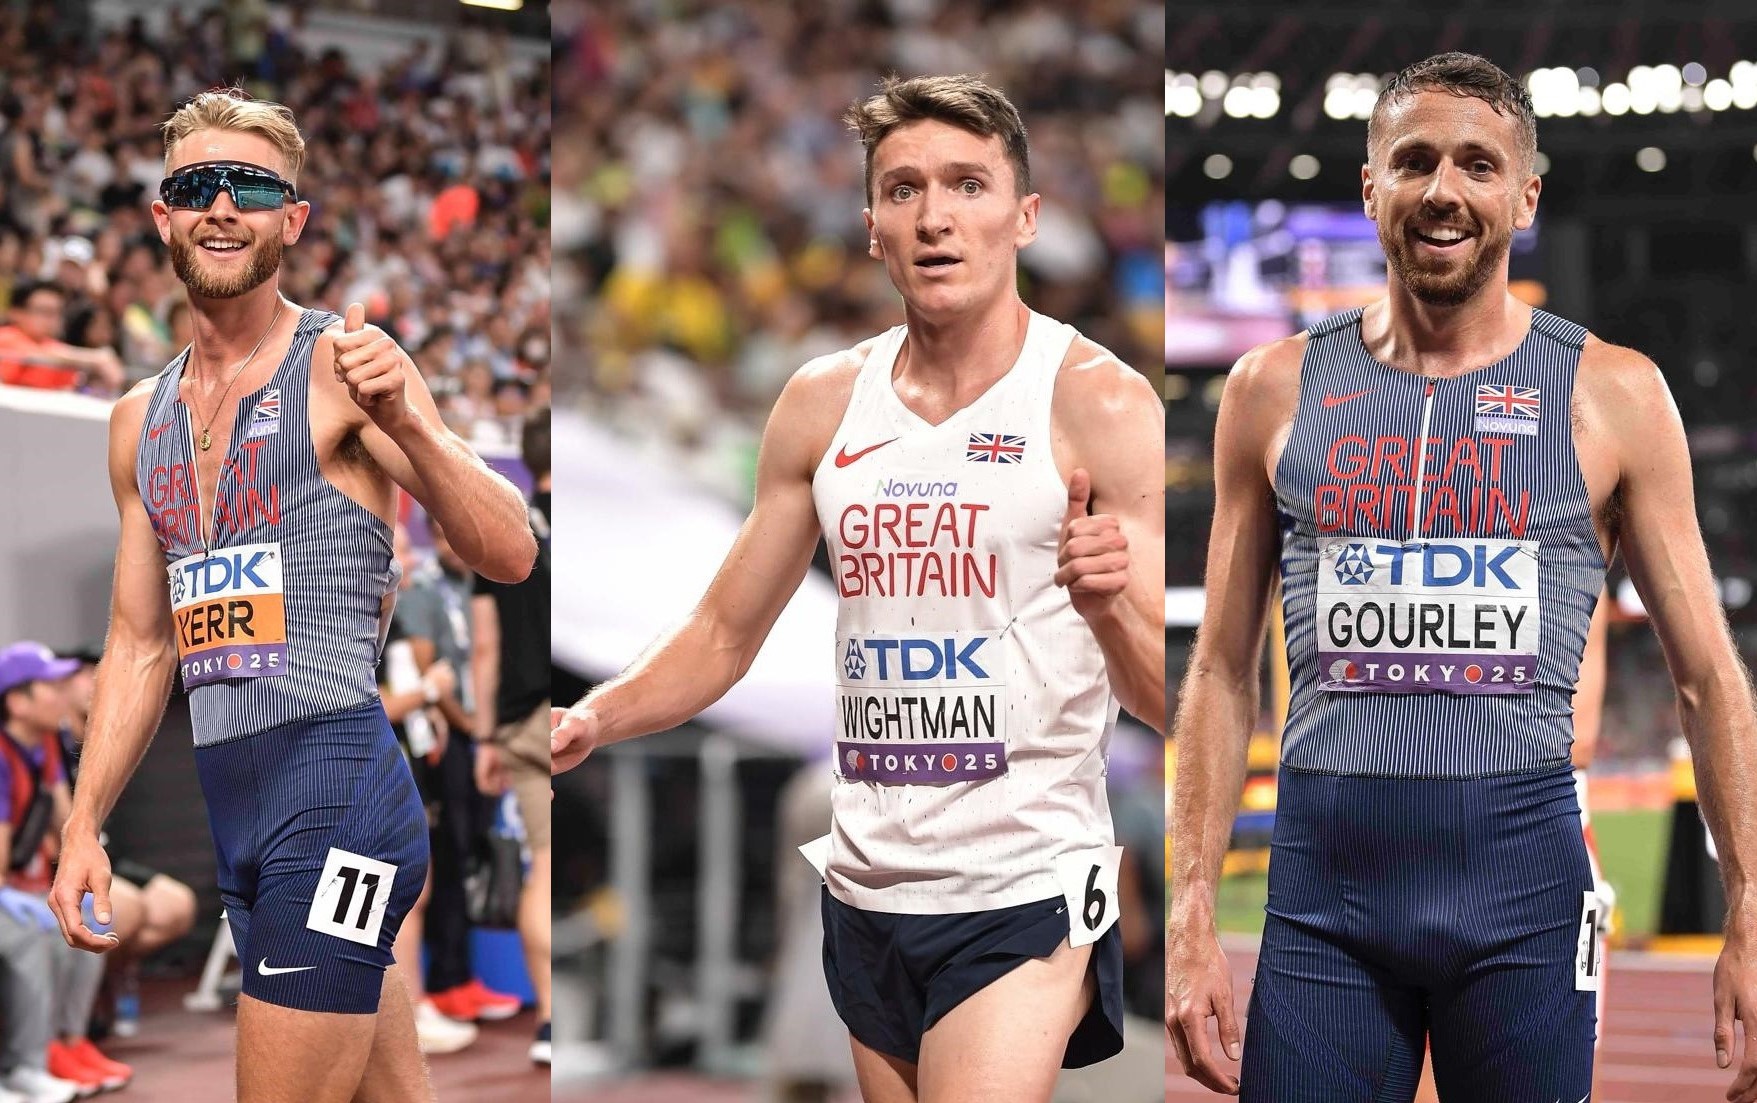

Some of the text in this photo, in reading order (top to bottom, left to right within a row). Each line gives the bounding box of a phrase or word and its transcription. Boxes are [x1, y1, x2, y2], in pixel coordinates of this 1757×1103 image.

[1475, 418, 1537, 435] Novuna
[1327, 435, 1515, 481] GREAT
[874, 478, 958, 497] Novuna
[1315, 483, 1530, 538] BRITAIN
[839, 502, 990, 549] GREAT
[184, 551, 269, 598] TDK
[840, 551, 996, 598] BRITAIN
[1376, 544, 1522, 590] TDK
[178, 600, 255, 648] KERR
[1328, 601, 1528, 650] GOURLEY
[864, 637, 990, 680] TDK
[842, 694, 995, 740] WIGHTMAN
[332, 866, 380, 930] 11
[1083, 864, 1106, 931] 6
